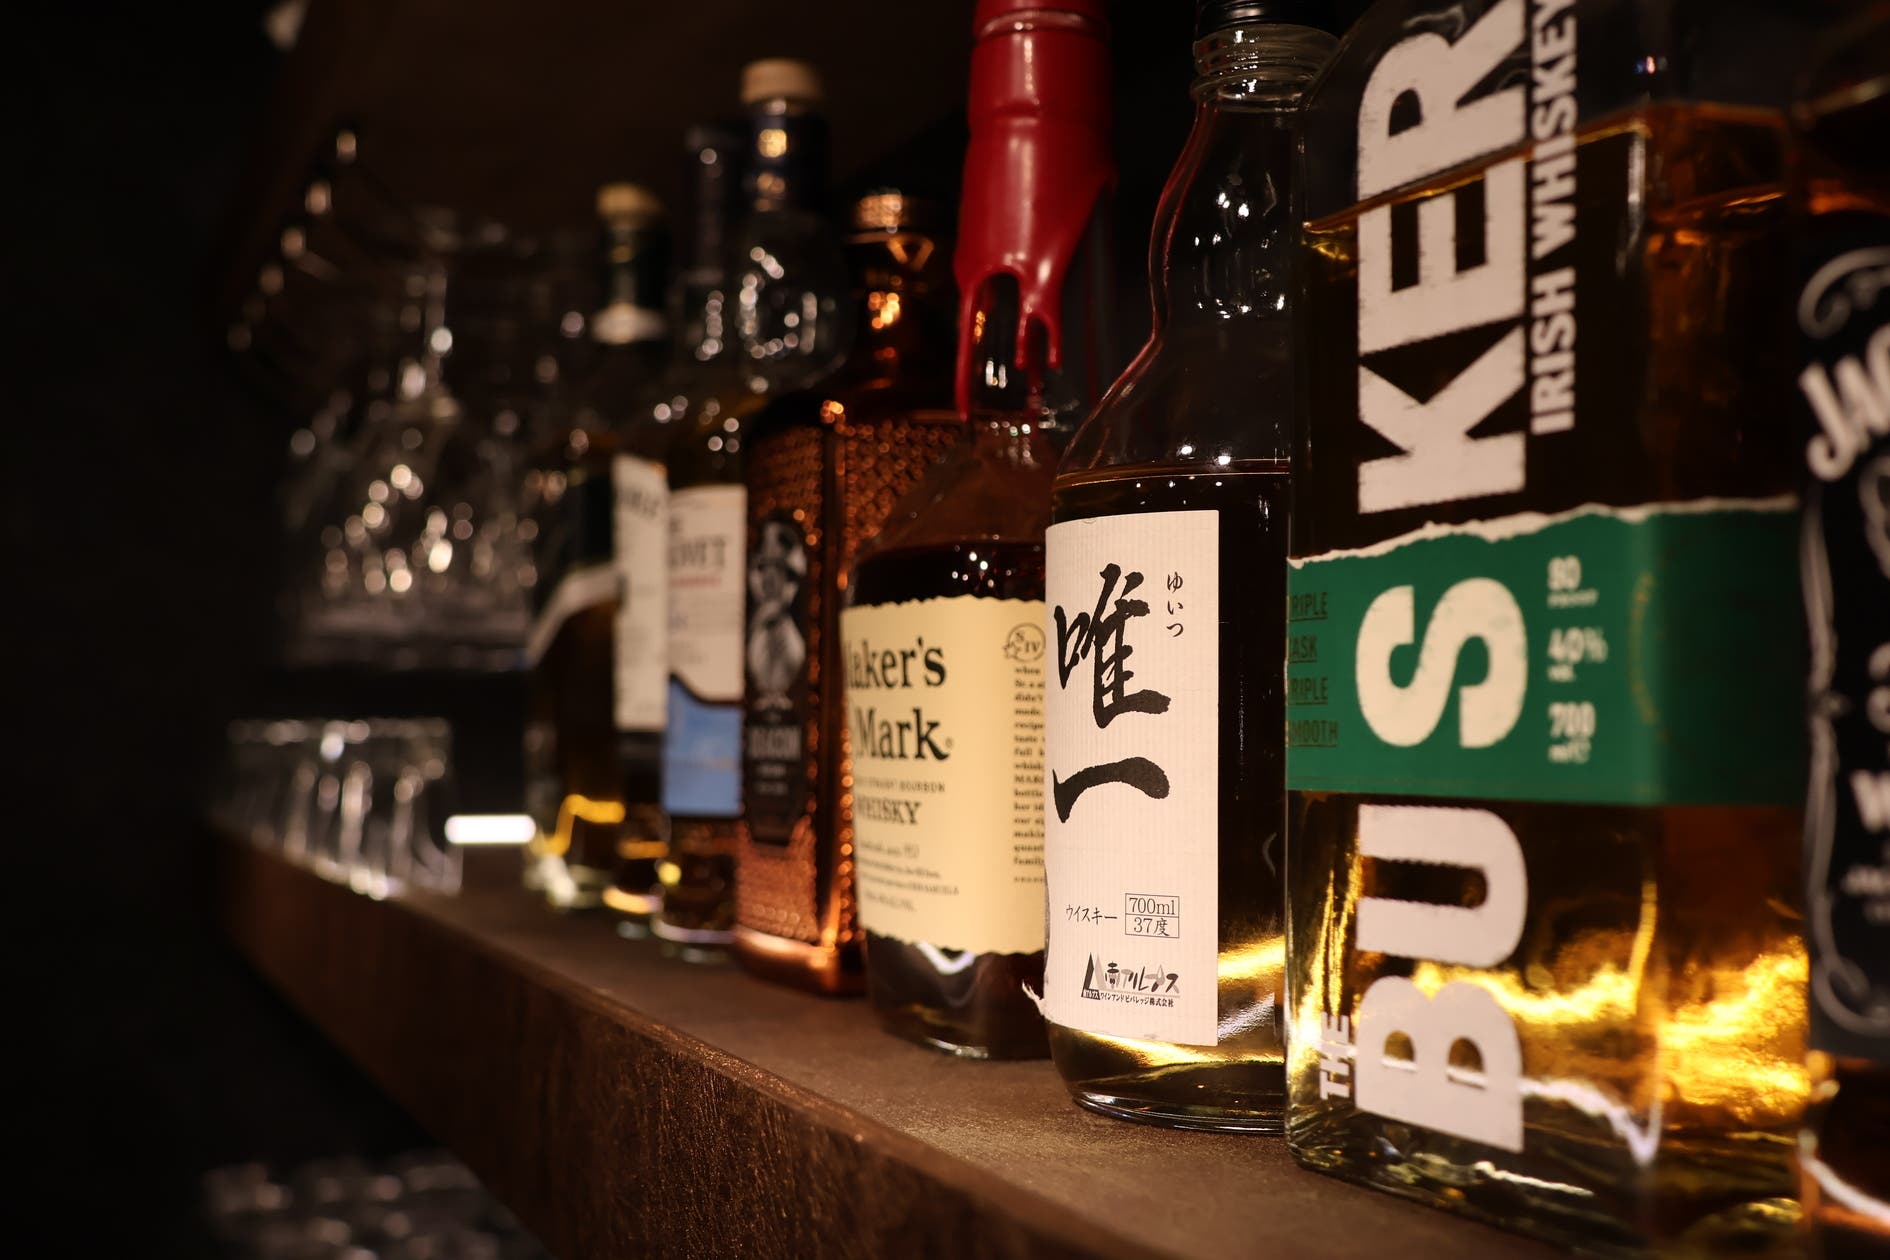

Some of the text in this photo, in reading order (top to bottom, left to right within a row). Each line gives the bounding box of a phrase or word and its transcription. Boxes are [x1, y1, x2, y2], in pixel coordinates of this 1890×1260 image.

[1531, 268, 1575, 435] IRISH
[1166, 571, 1184, 638] ゆいつ
[1288, 591, 1329, 618] RIPLE
[1287, 635, 1318, 660] ASK
[1052, 562, 1172, 824] 唯一
[1288, 677, 1329, 701] RIPLE
[1548, 701, 1597, 739] 700
[1066, 903, 1118, 926] ウイスキー
[1128, 896, 1176, 917] 700ml
[1133, 916, 1170, 937] 37度
[1319, 1011, 1350, 1101] THE
